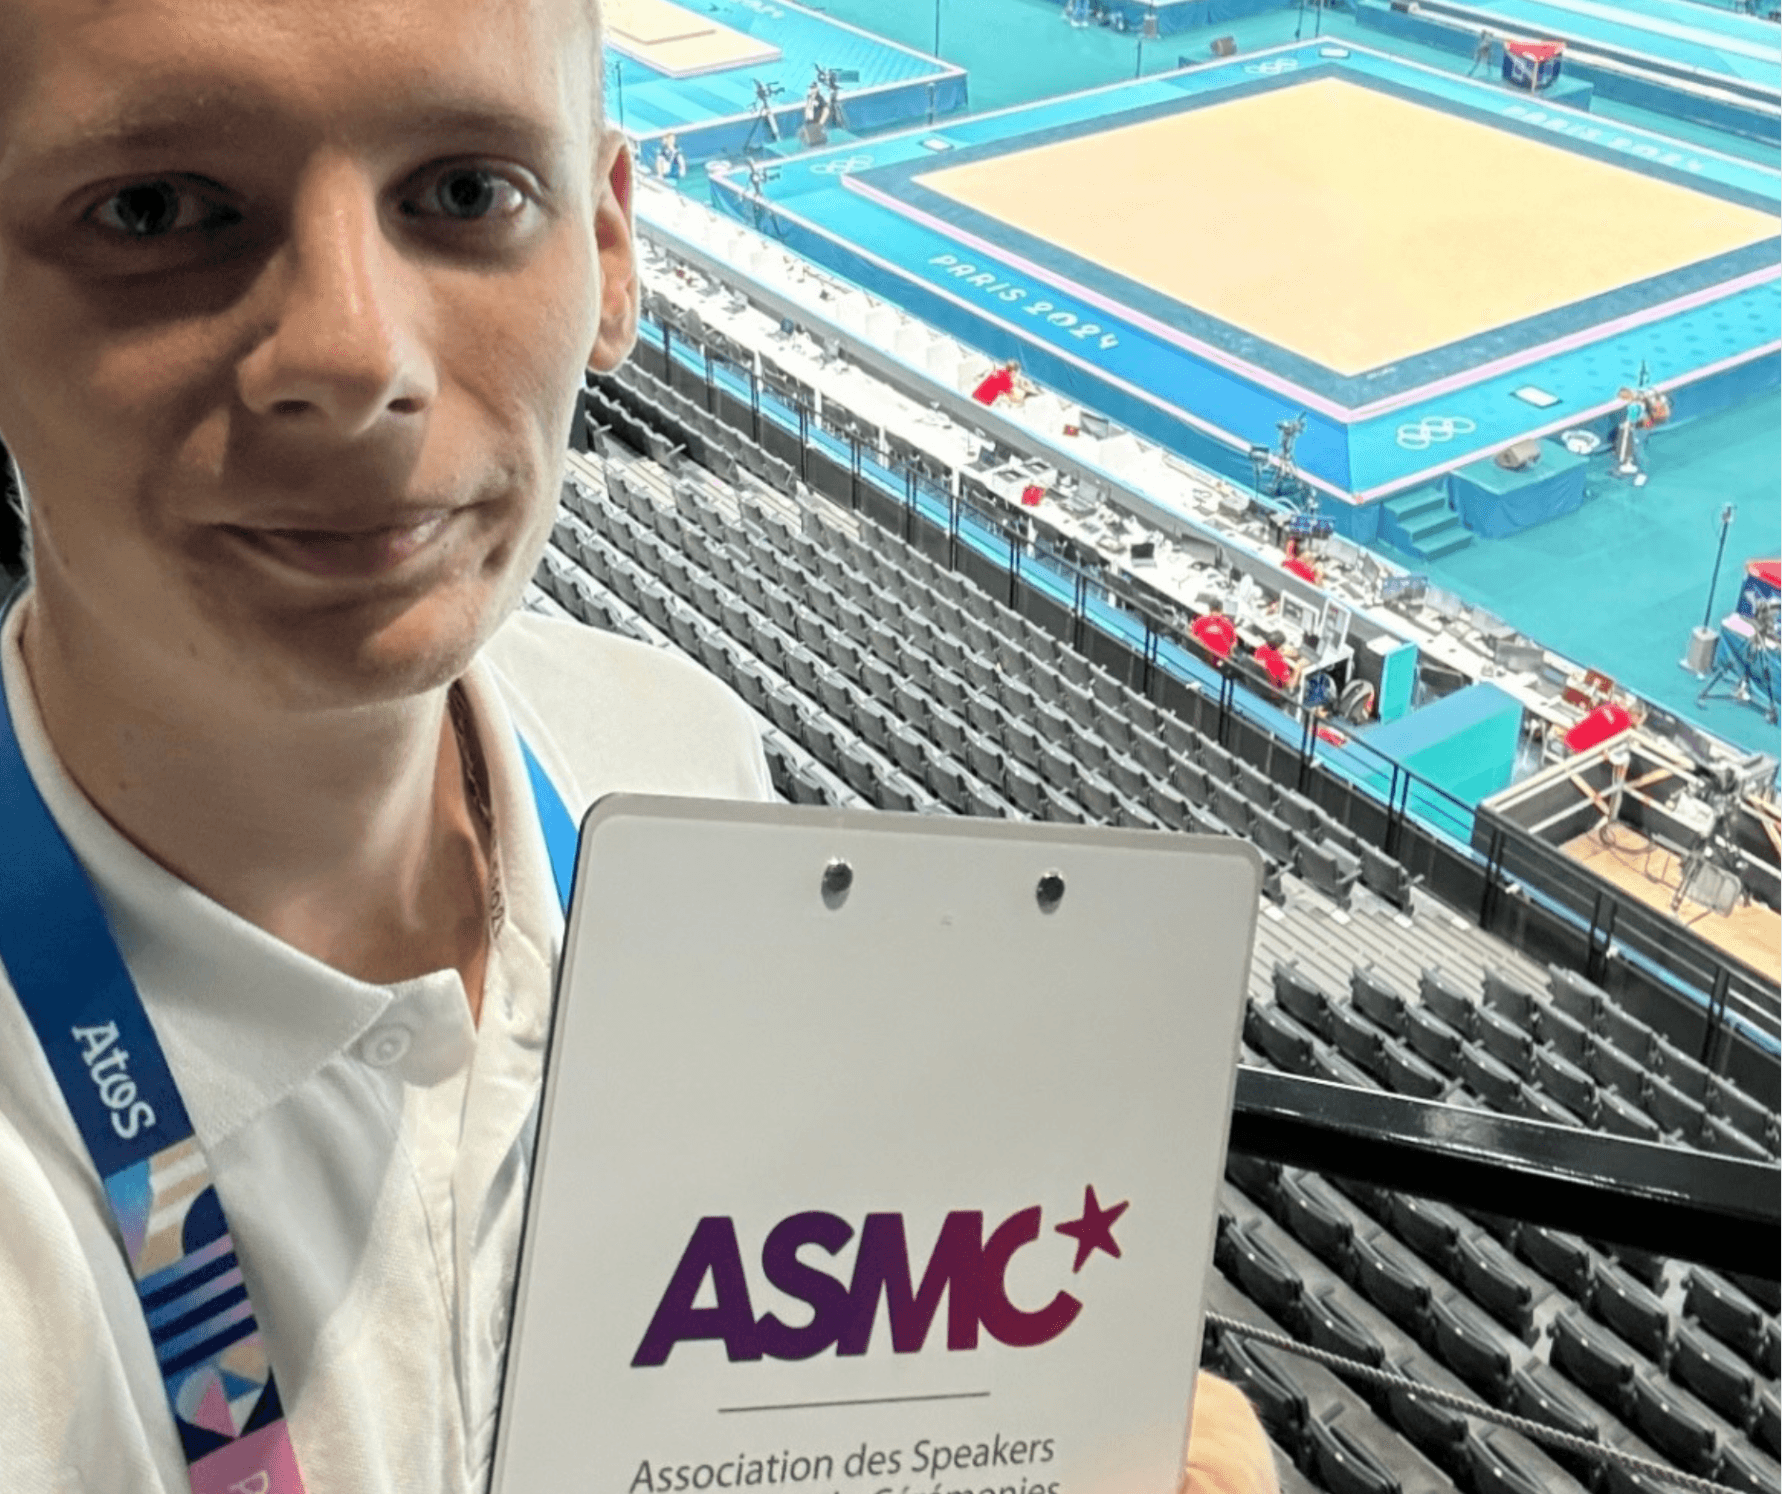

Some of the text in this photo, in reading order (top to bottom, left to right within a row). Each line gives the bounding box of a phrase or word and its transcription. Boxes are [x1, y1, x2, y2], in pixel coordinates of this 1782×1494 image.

[928, 254, 1120, 350] PARIS 2024
[71, 1020, 156, 1140] Atos
[630, 1204, 1083, 1368] ASMC
[629, 1451, 834, 1494] Association
[844, 1442, 903, 1479] des
[911, 1432, 1056, 1480] Speakers
